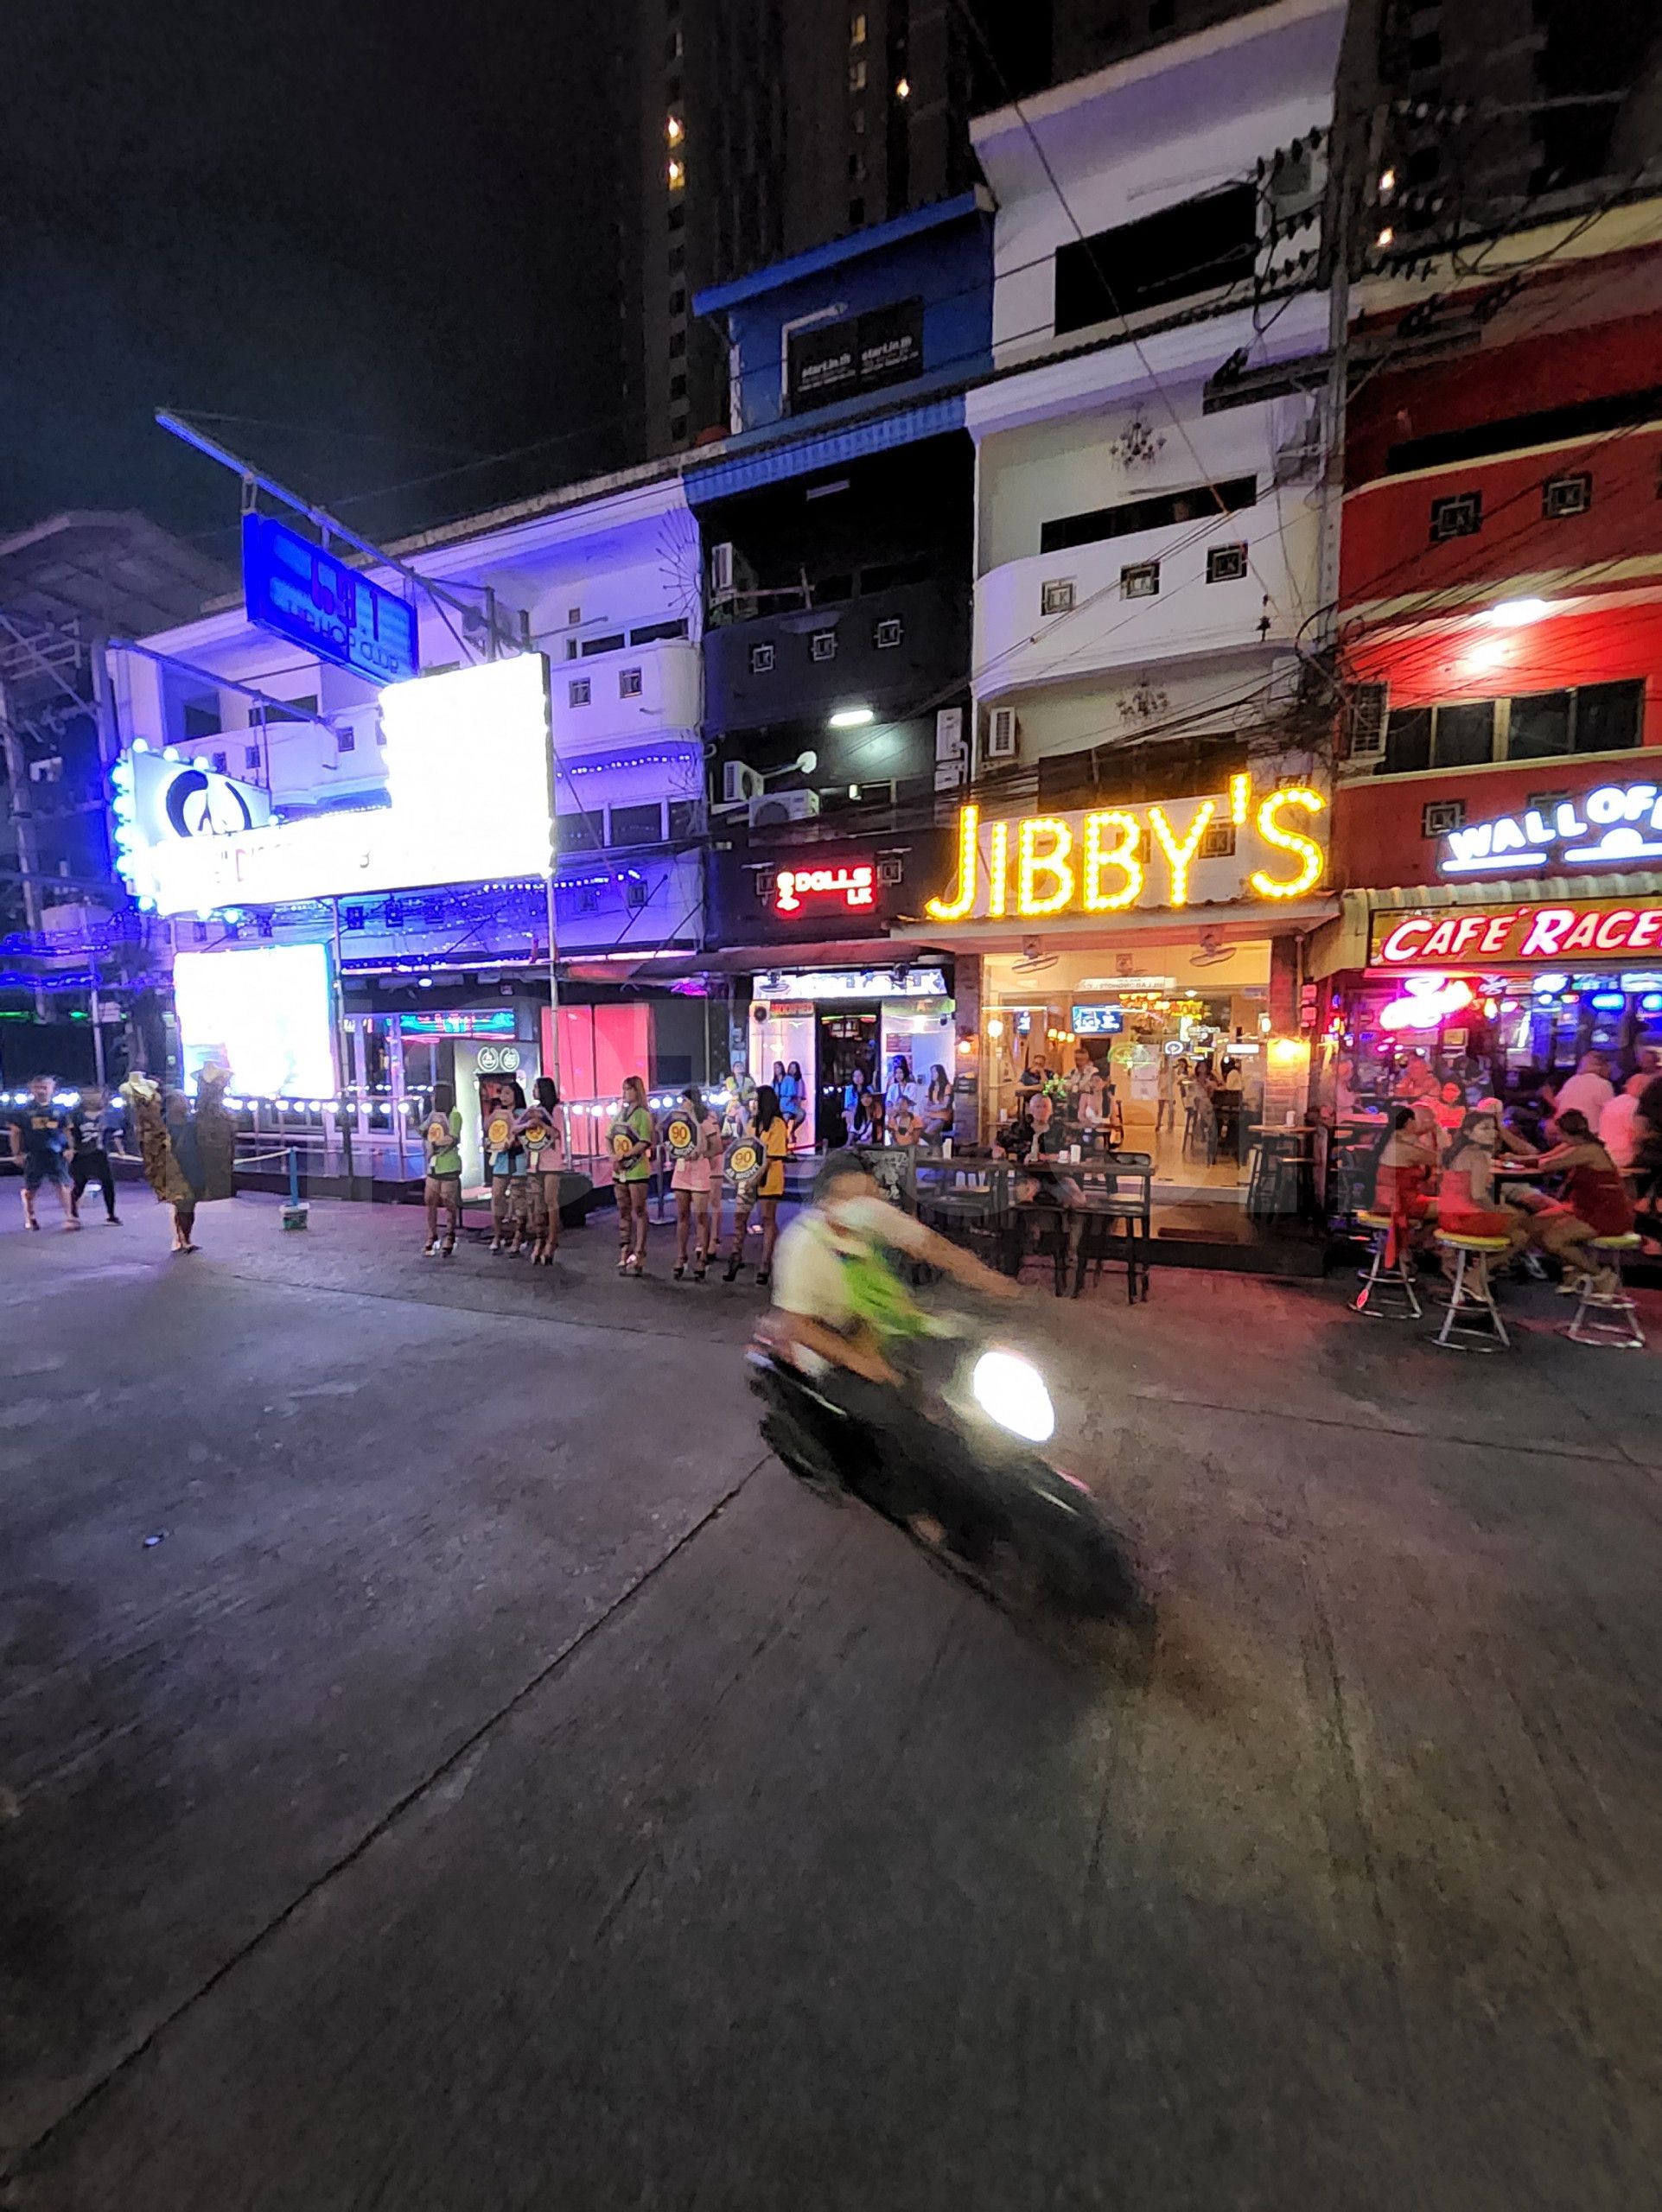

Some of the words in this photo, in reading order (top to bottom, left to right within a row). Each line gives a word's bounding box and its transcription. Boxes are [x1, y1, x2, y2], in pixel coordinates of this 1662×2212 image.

[925, 772, 1328, 921] JIBBY'S
[1448, 802, 1588, 861] WALL
[795, 867, 872, 892] DOLLS
[847, 887, 873, 905] LK
[1519, 906, 1662, 957] RACE
